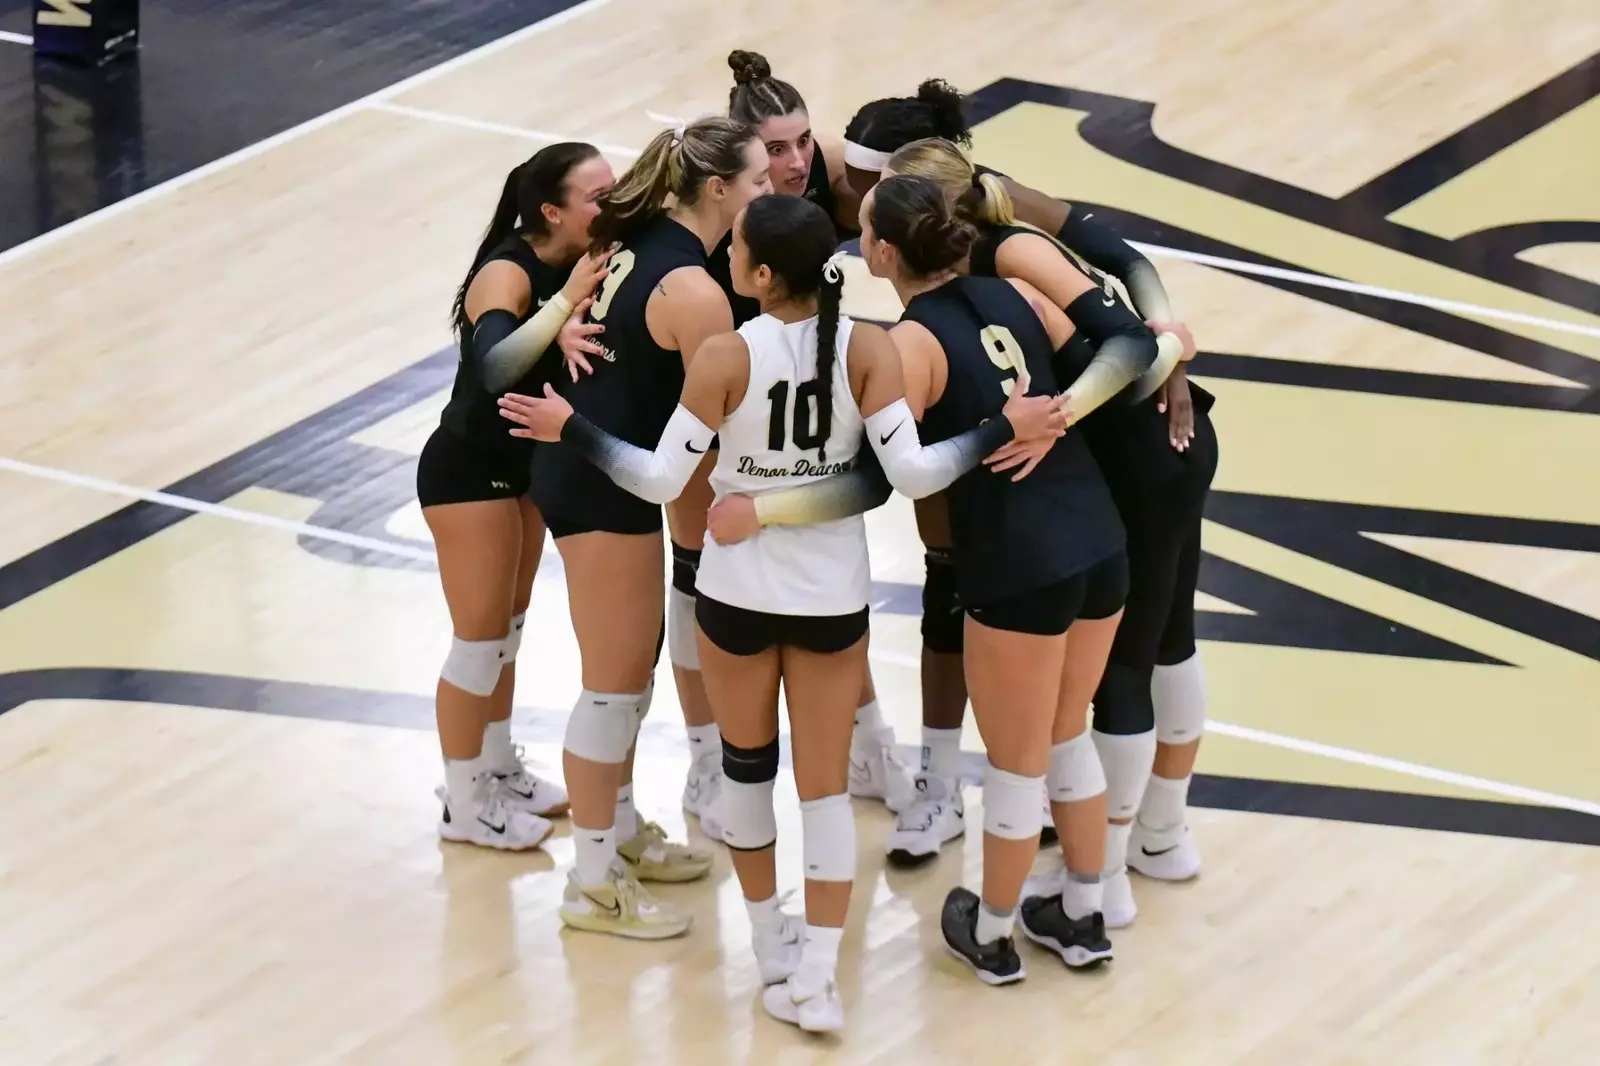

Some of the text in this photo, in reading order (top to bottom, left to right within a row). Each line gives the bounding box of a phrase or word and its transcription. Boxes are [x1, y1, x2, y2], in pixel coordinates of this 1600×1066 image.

[980, 324, 1031, 397] 9
[768, 379, 833, 452] 10
[737, 456, 788, 478] Demon
